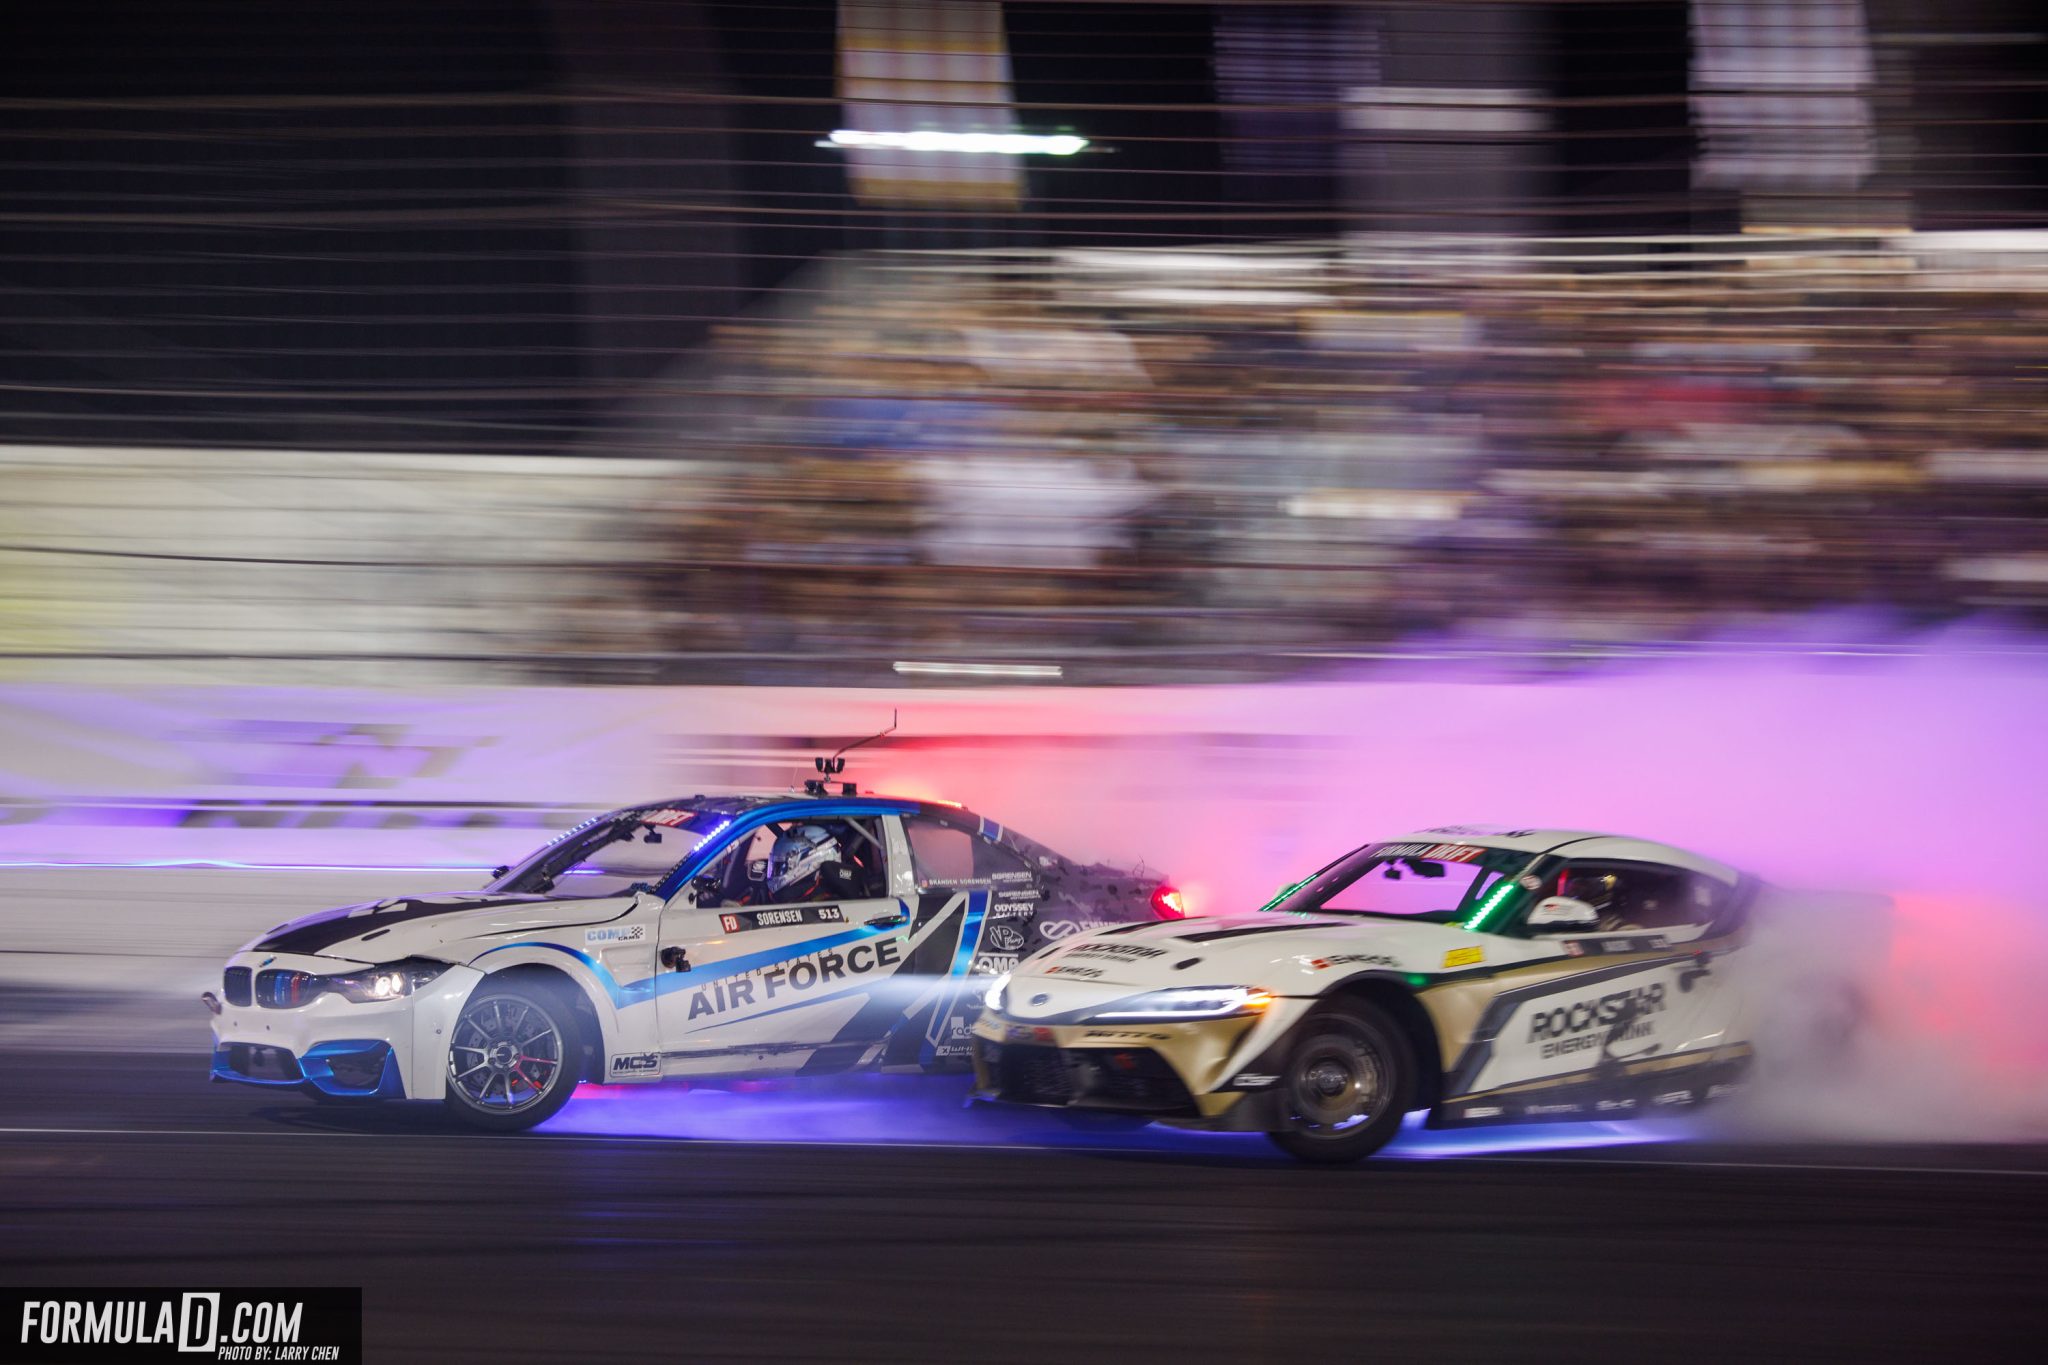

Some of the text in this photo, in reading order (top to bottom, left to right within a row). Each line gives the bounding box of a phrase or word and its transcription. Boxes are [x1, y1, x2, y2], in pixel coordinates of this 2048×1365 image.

[994, 903, 1034, 913] ODYSSEY
[723, 907, 840, 931] FD SORENSEN 513
[618, 934, 641, 942] CAMS
[687, 936, 901, 1021] AIR FORCE
[700, 967, 763, 992] UNITED
[613, 1056, 658, 1071] MCS
